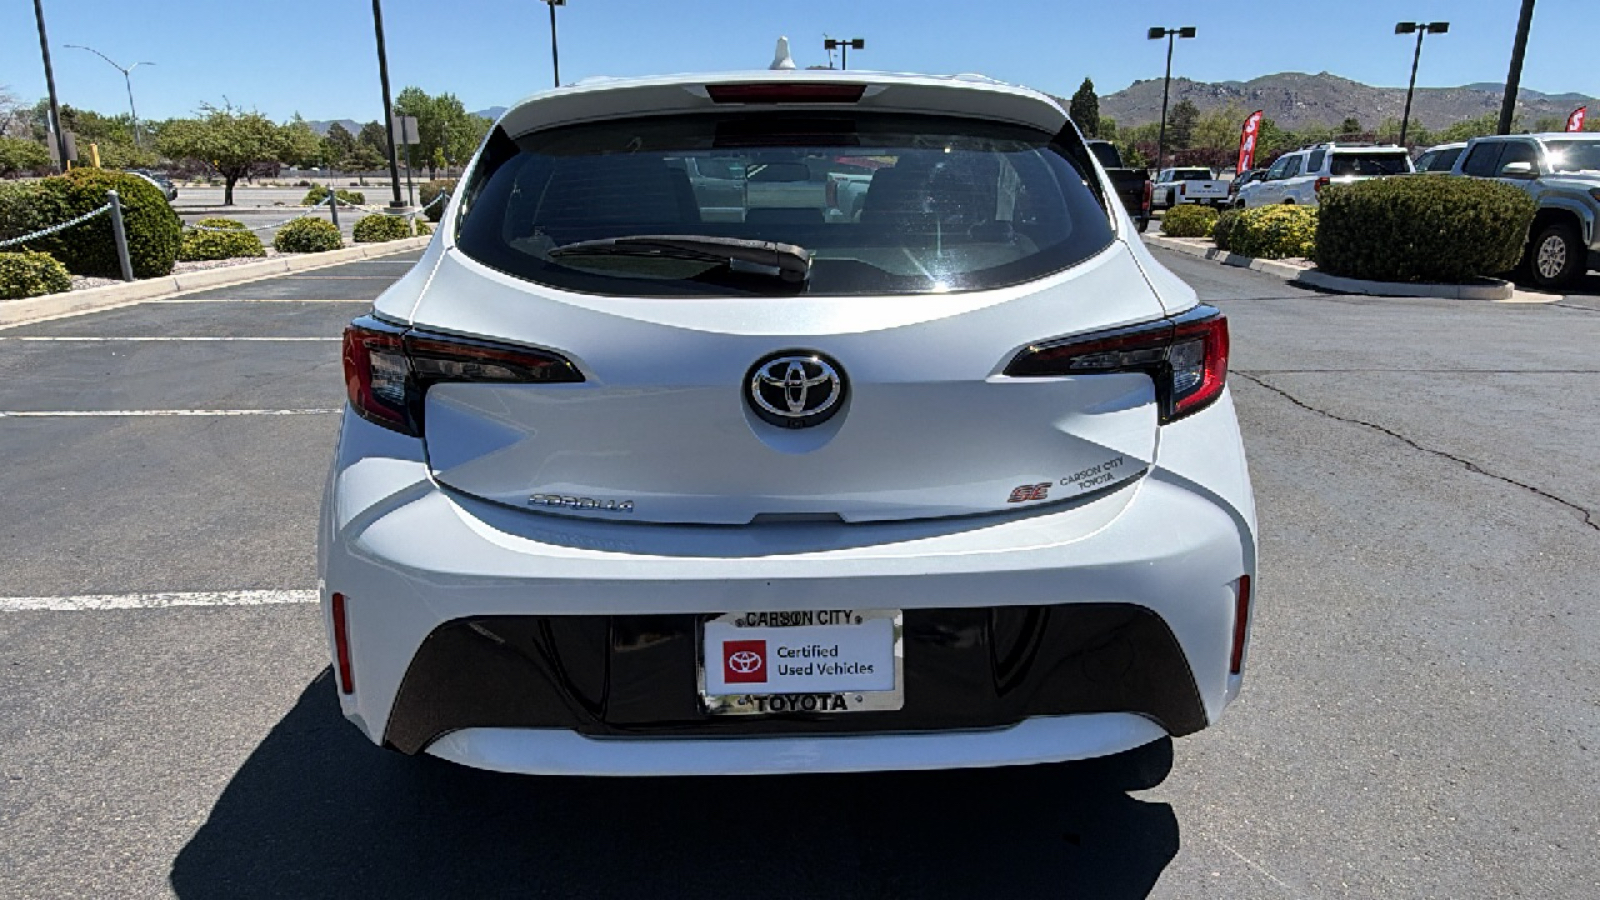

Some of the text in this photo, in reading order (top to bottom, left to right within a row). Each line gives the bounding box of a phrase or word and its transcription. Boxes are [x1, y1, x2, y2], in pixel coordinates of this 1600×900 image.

[1060, 456, 1124, 486] CARSON CITY
[1078, 472, 1115, 490] TOYOTA
[1007, 482, 1053, 503] SE
[528, 494, 634, 512] COROLLA
[746, 610, 853, 626] CARSON CITY
[777, 645, 838, 658] Certified
[778, 662, 874, 675] Used Vehicles
[757, 694, 848, 711] TOYOTA
